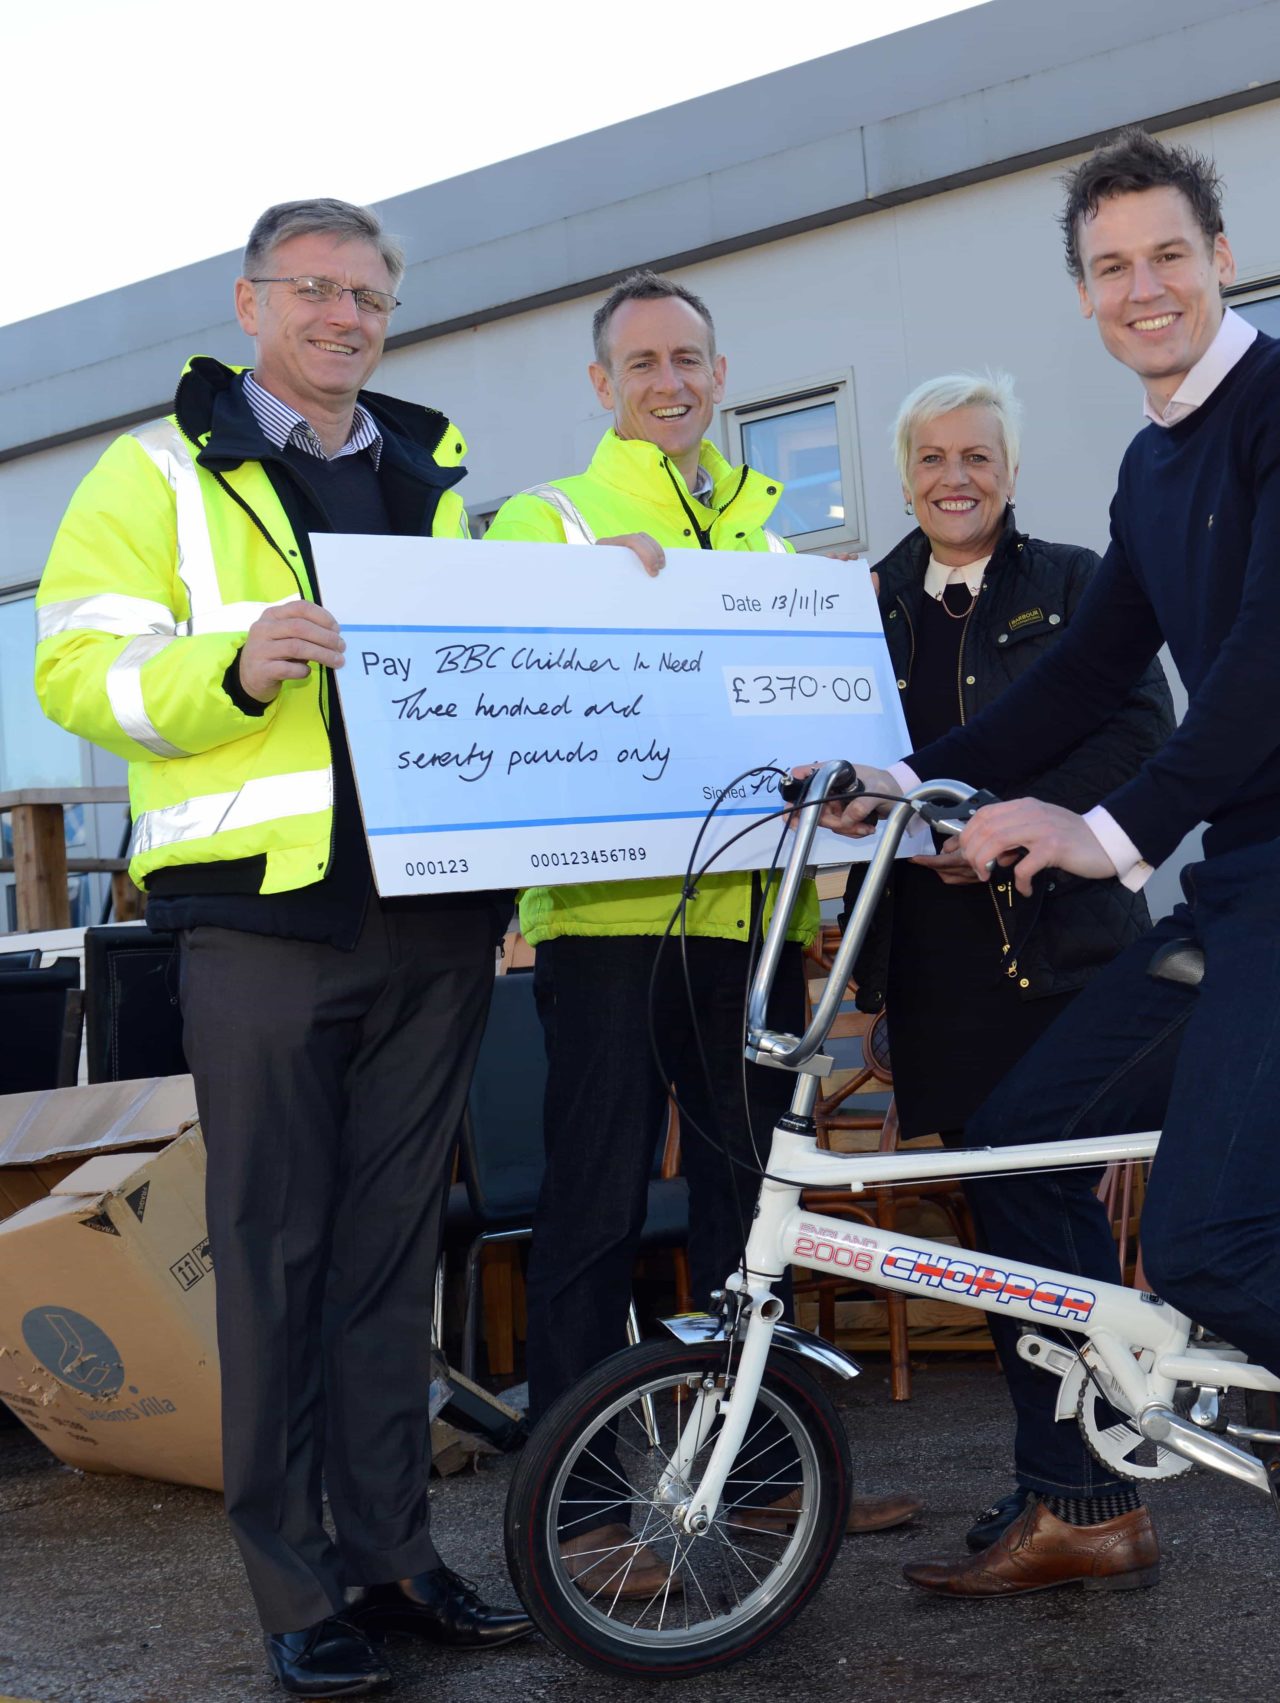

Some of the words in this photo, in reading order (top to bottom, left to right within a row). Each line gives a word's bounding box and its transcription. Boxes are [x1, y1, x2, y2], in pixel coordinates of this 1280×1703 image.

[722, 594, 762, 612] Date
[771, 588, 840, 617] 13/11/15
[361, 651, 412, 682] Pay
[435, 644, 505, 674] BBC
[511, 647, 620, 673] Children
[633, 652, 651, 671] In
[659, 650, 703, 673] Need
[391, 687, 458, 721] Three
[475, 692, 572, 717] hundred
[584, 694, 644, 718] and
[398, 742, 494, 783] seventy
[508, 741, 598, 775] pounds
[617, 739, 671, 781] only
[405, 858, 469, 877] 000123
[530, 847, 647, 868] 000123456789
[794, 1238, 874, 1271] 2006
[880, 1246, 1097, 1323] CHOPPER
[136, 1396, 177, 1417] Villa
